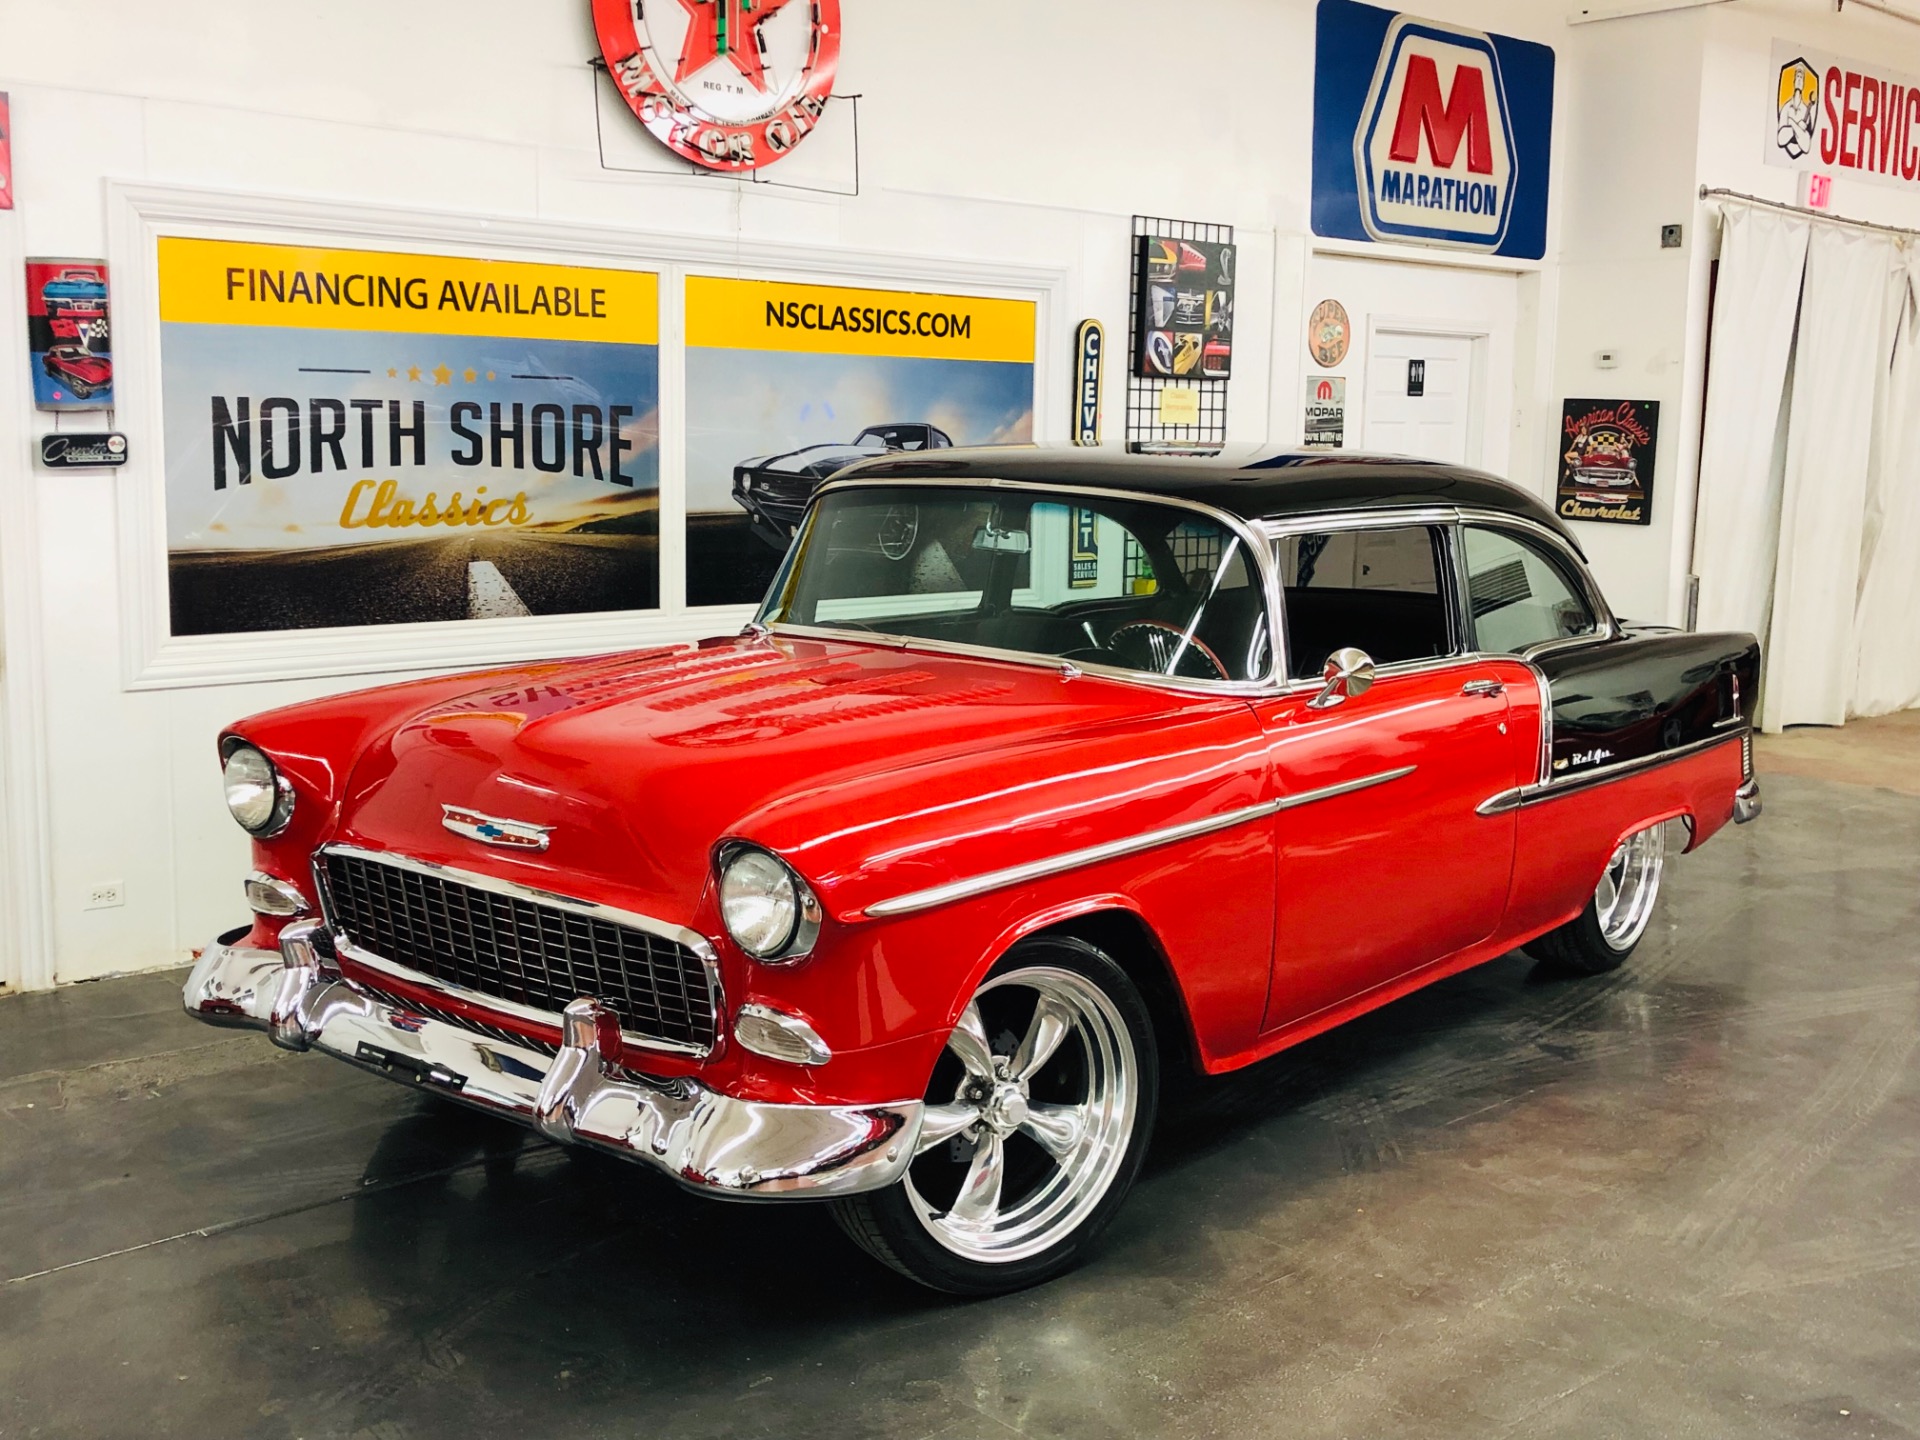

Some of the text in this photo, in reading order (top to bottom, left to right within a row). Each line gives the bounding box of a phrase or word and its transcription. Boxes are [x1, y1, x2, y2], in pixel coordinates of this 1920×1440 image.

[703, 81, 744, 95] REG T M
[1388, 53, 1493, 175] M
[1820, 66, 1920, 182] SERVIC
[1380, 169, 1497, 216] MARATHON
[1809, 174, 1832, 208] EXIT
[226, 267, 608, 319] FINANCING AVAILABLE
[765, 300, 971, 339] NSCLASSICS.COM
[1305, 407, 1344, 418] MOPAR
[1565, 409, 1615, 439] American
[210, 395, 634, 491] NORTH SHORE
[1319, 431, 1336, 442] WITH
[1335, 433, 1343, 442] US
[338, 478, 534, 531] Classics
[1560, 499, 1641, 520] Chevrolet
[1073, 562, 1092, 571] SALES
[1073, 570, 1097, 579] SERVICE
